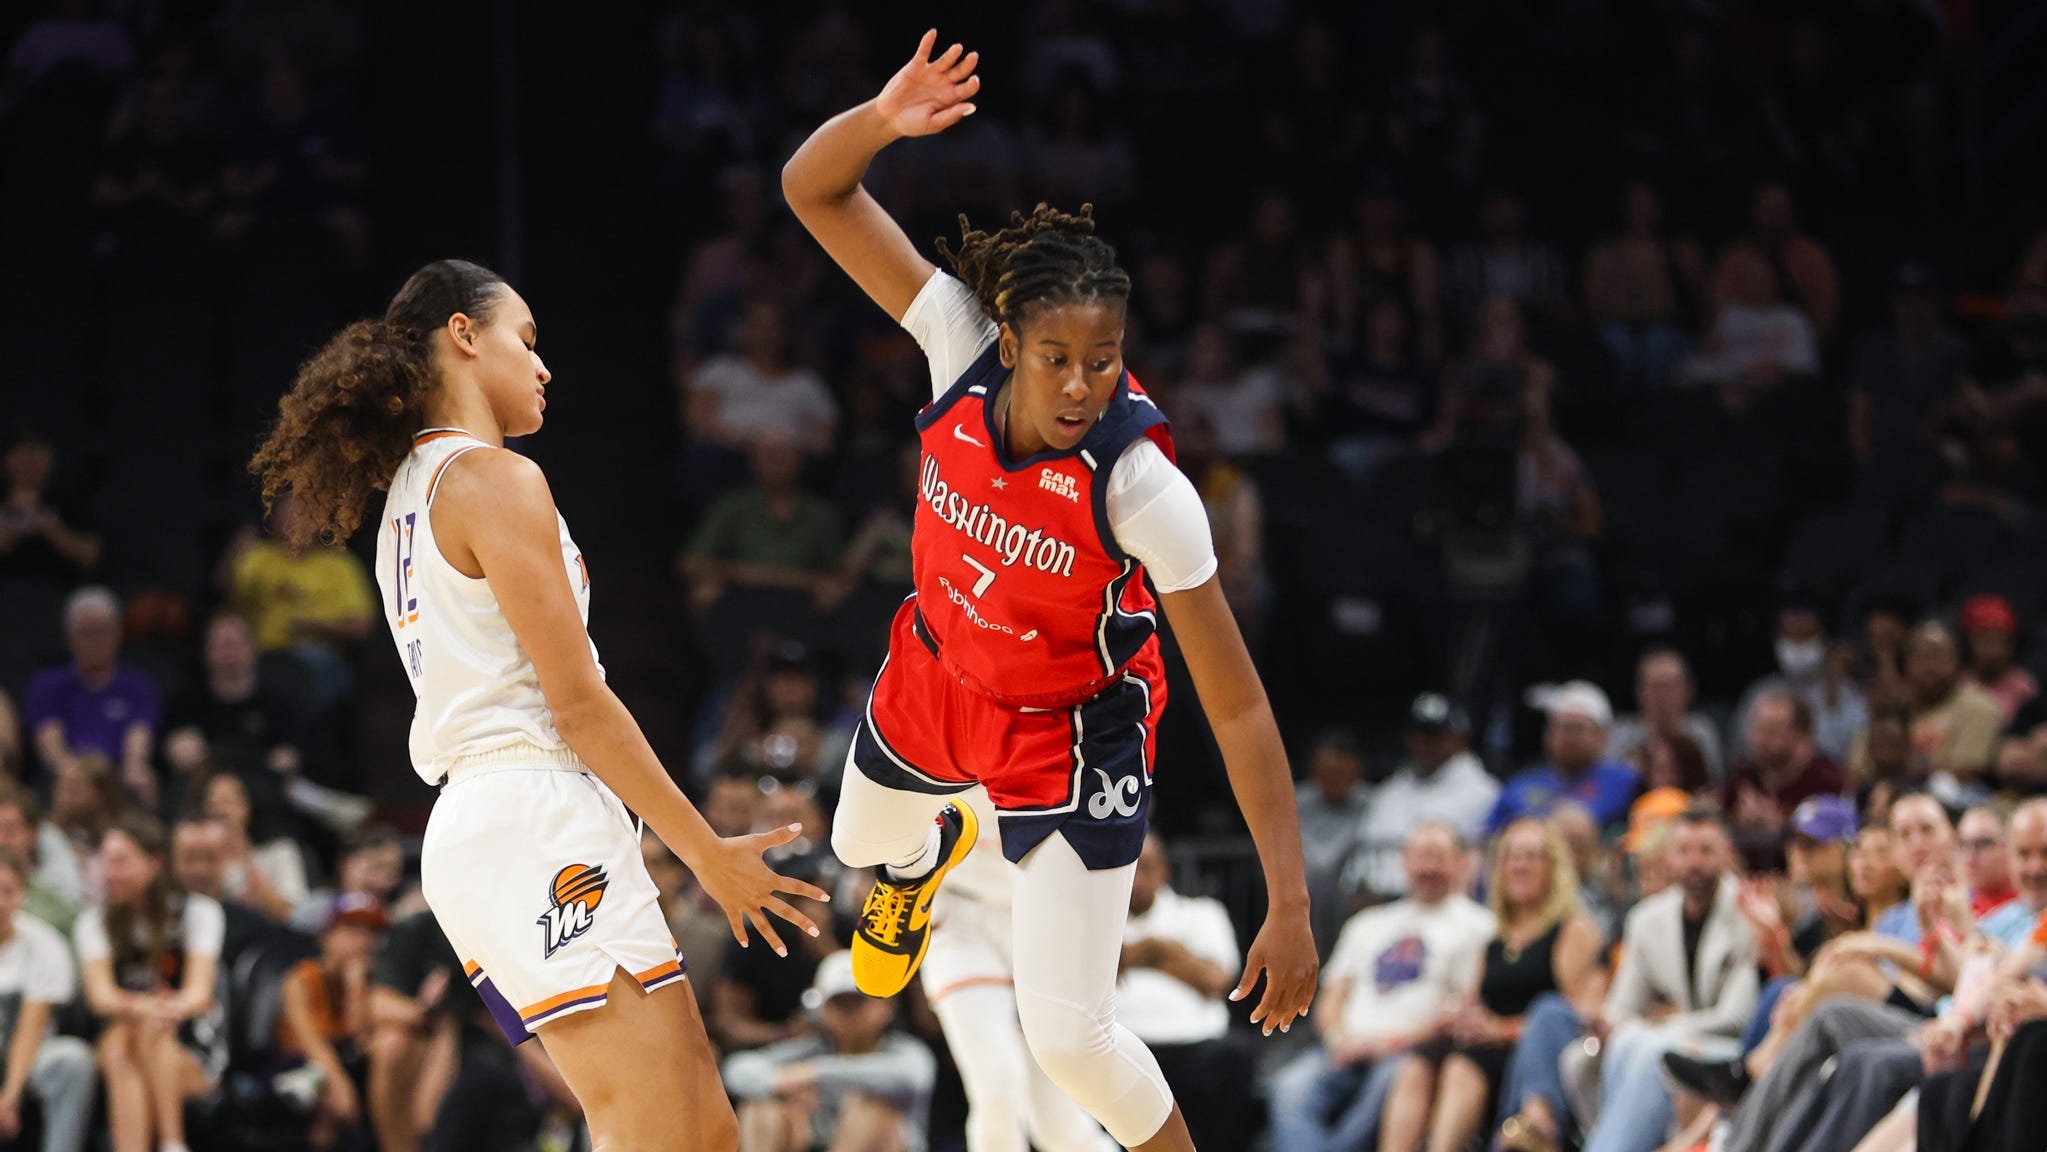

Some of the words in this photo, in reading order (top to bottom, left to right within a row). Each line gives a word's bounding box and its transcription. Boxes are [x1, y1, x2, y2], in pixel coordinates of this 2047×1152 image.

[1038, 477, 1079, 503] max
[1041, 468, 1076, 489] CAR
[921, 453, 1076, 577] Washington
[391, 512, 419, 629] 12
[962, 553, 997, 600] 7
